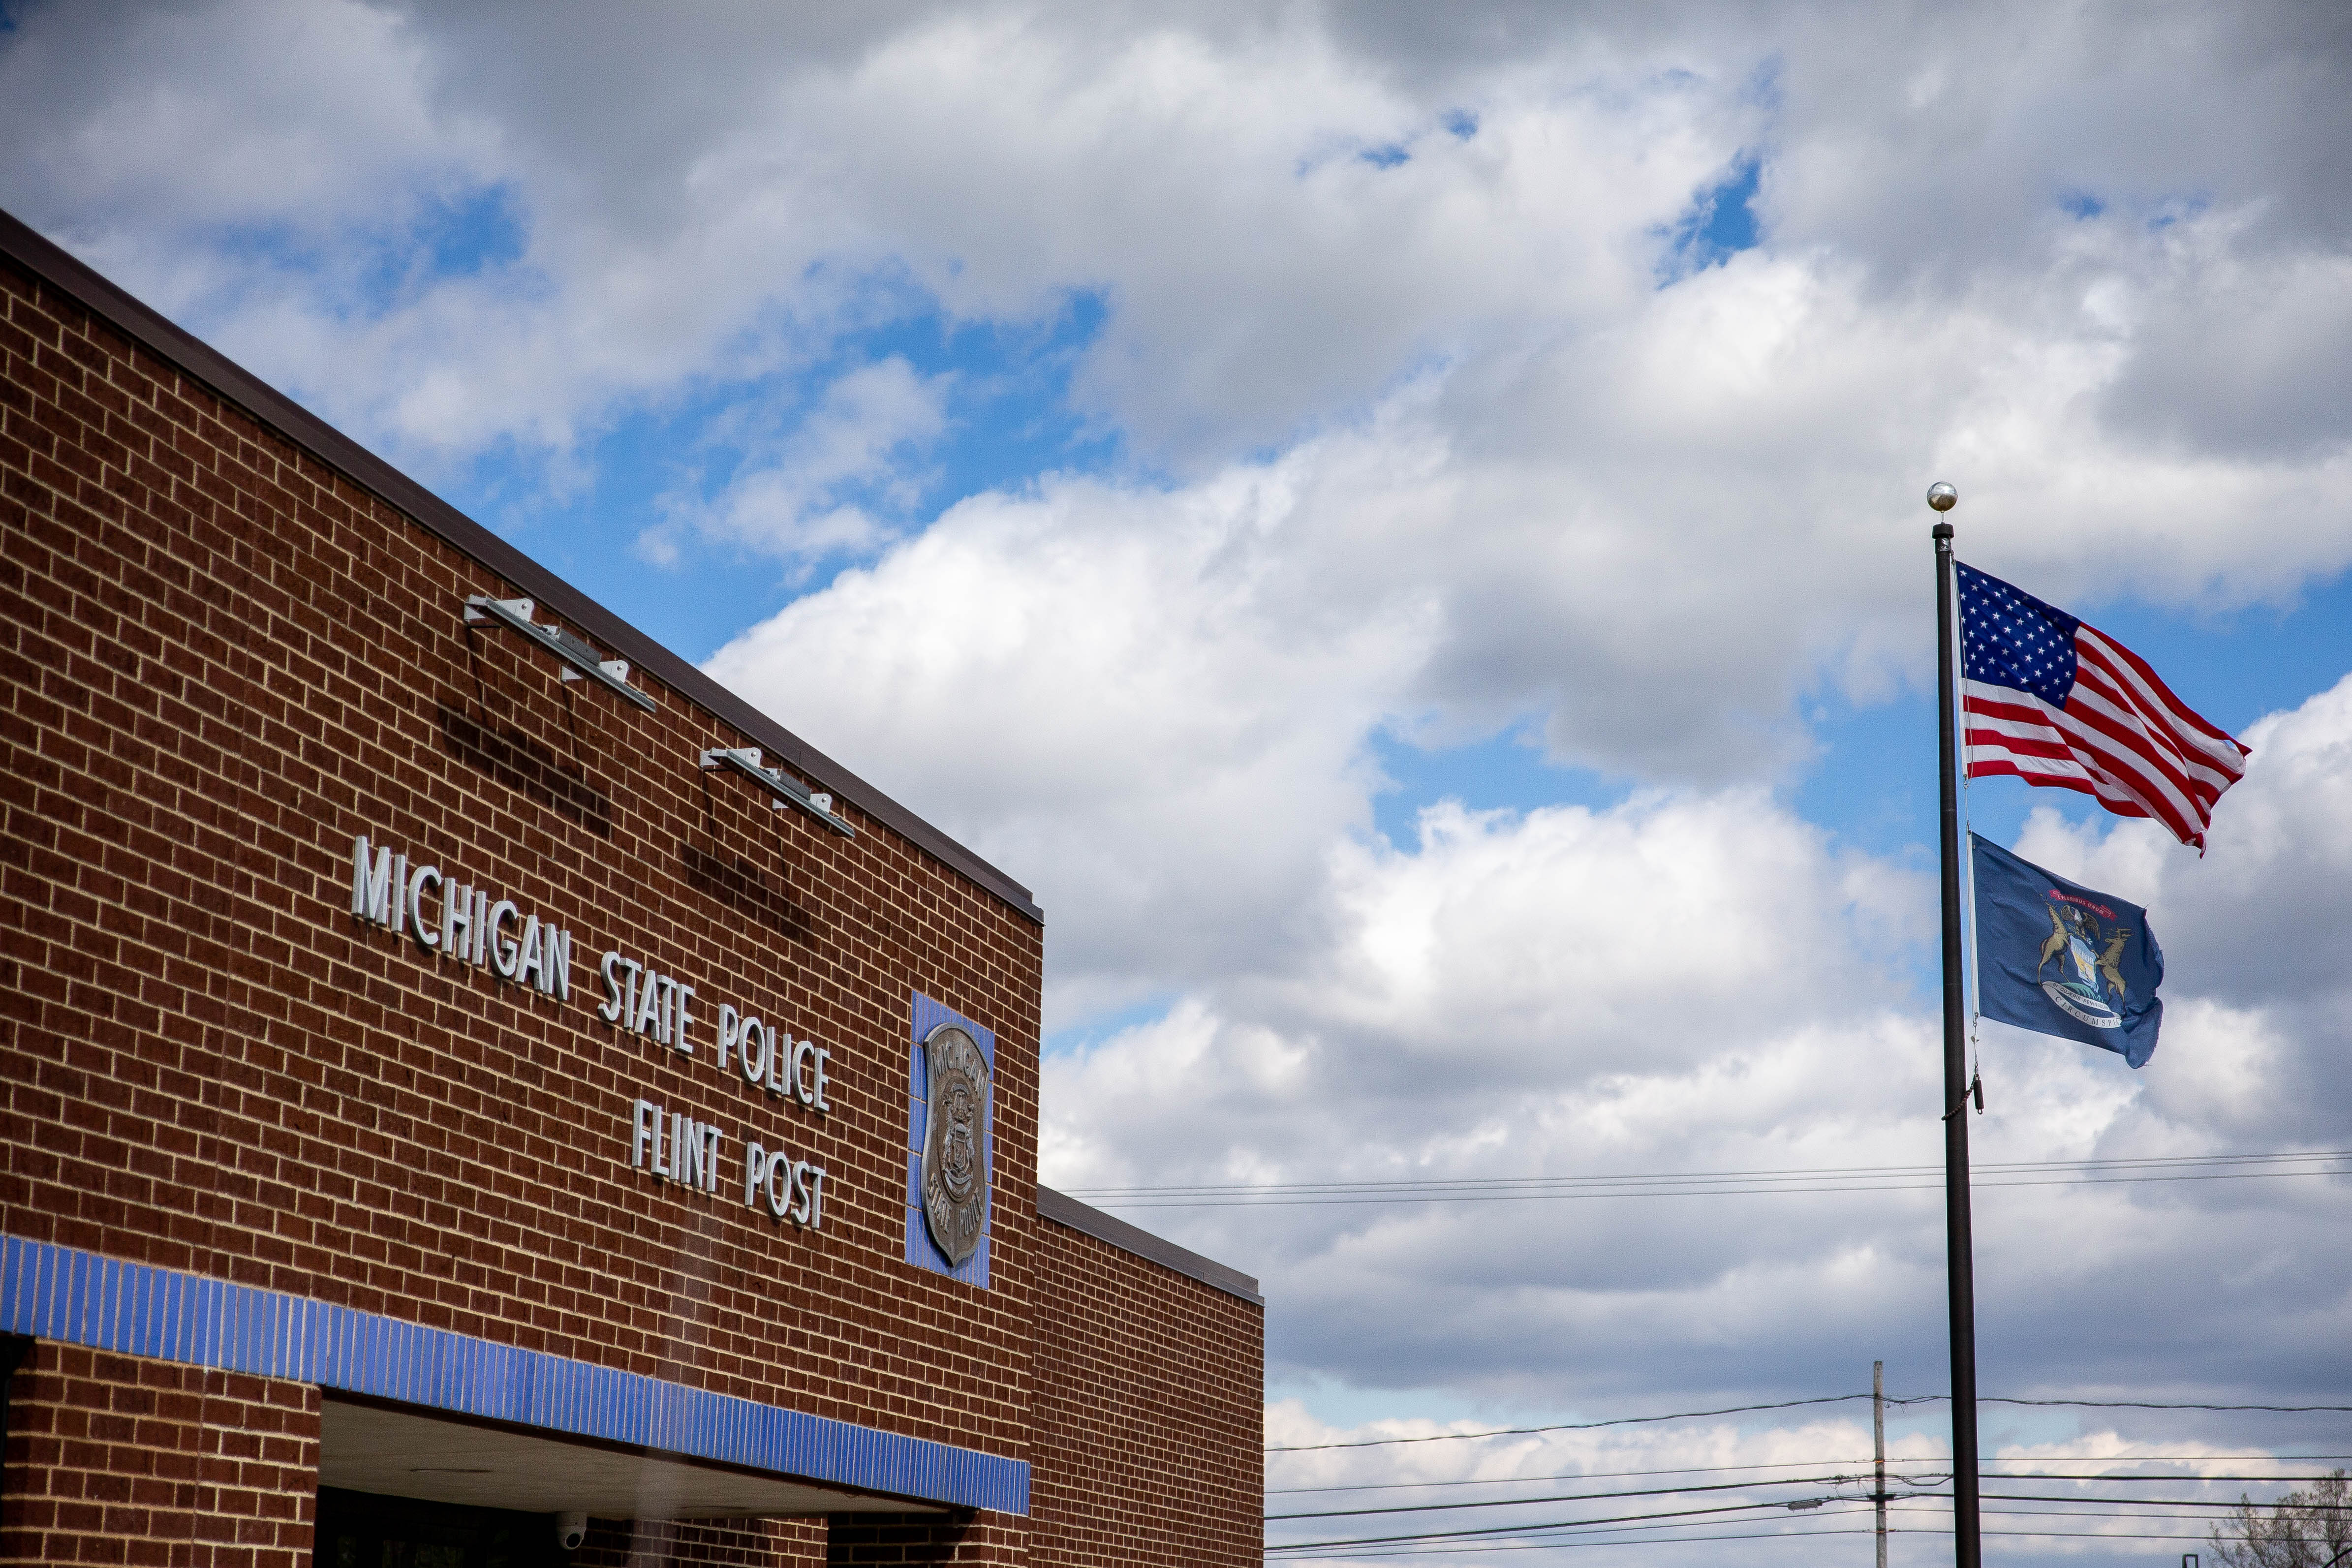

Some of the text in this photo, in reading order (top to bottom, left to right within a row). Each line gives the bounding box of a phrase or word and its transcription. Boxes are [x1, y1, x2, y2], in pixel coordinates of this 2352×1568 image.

[2088, 902, 2104, 914] UNUM
[351, 836, 830, 1111] MICHIGAN STATE POLICE
[931, 1041, 985, 1099] MICHIGAN
[632, 1099, 826, 1228] FLINT POST
[928, 1173, 984, 1238] STATE POLICE
